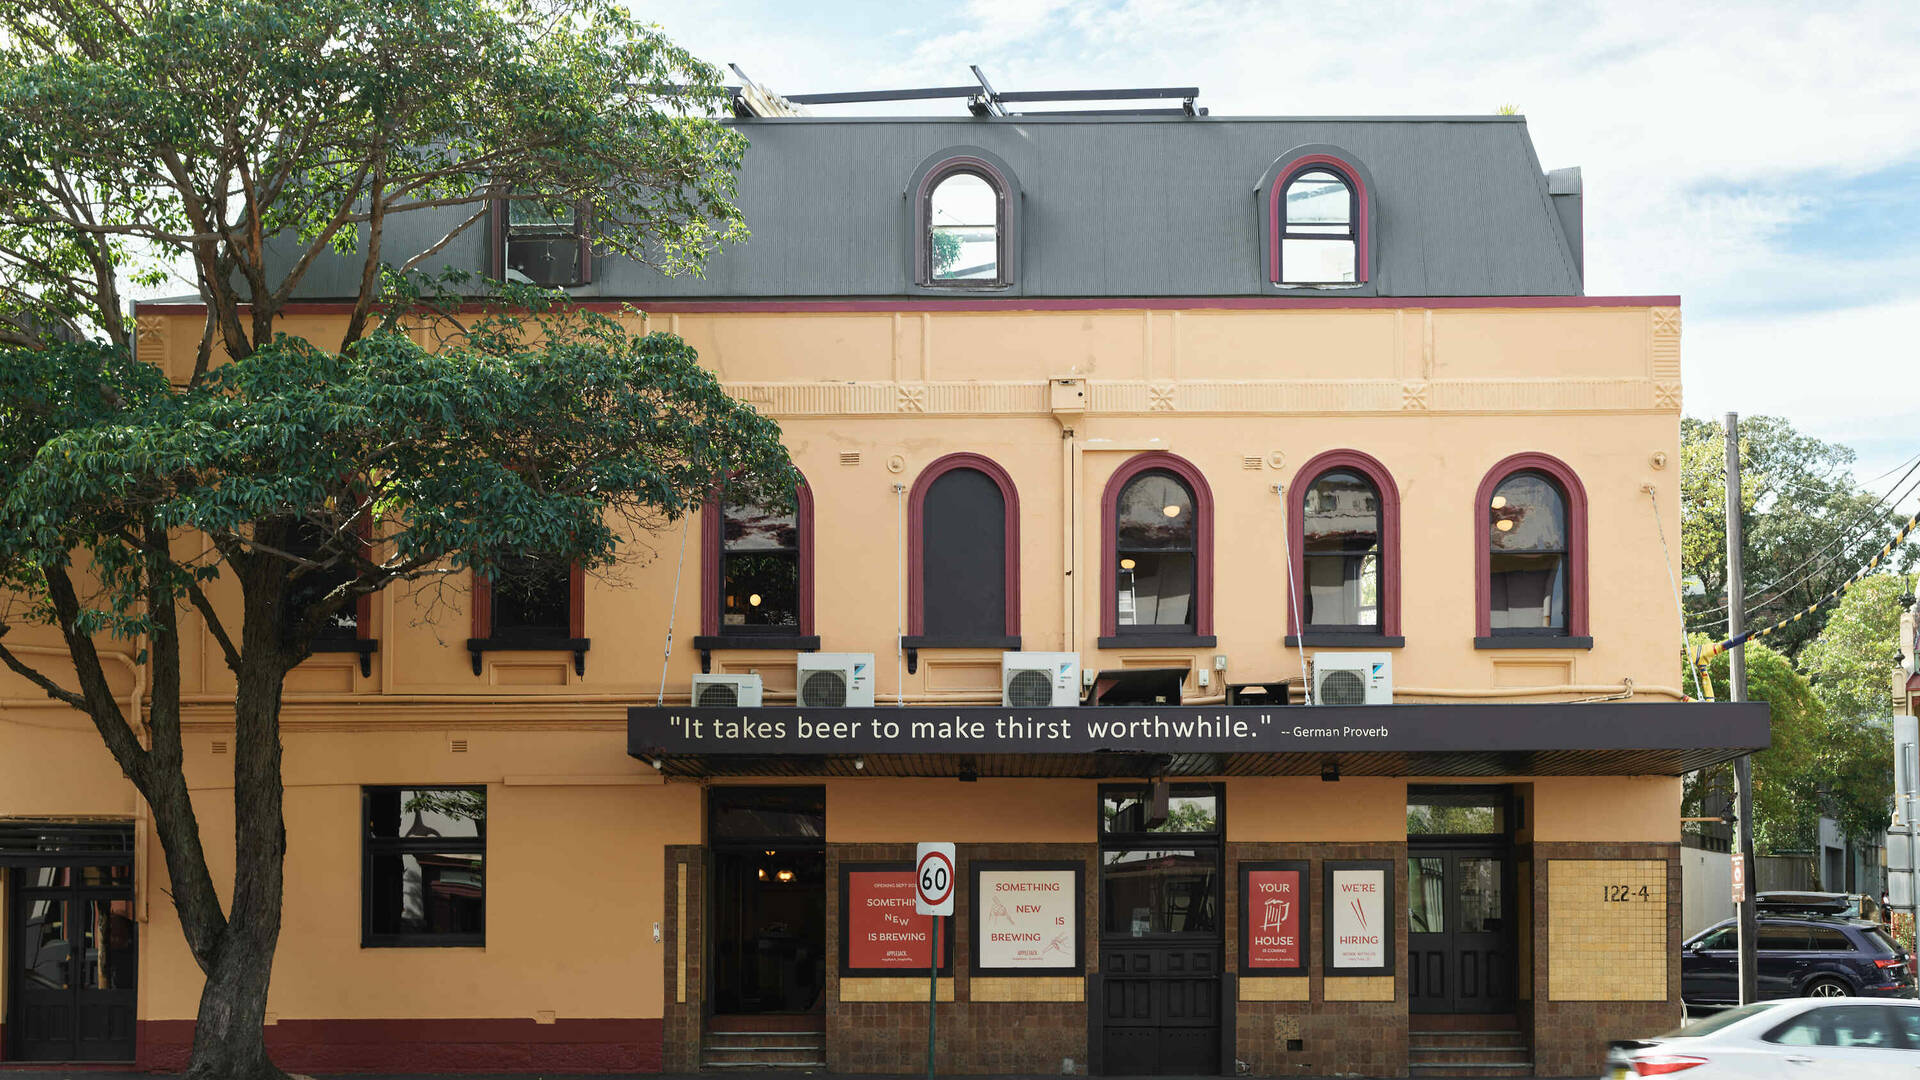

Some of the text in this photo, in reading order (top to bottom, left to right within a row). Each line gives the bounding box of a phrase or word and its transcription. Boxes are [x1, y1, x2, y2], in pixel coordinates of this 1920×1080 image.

[670, 714, 1271, 739] "It takes beer to make thirst worthwhile."
[1293, 726, 1340, 738] German
[1344, 725, 1389, 738] Proverb
[922, 867, 947, 891] 60
[995, 882, 1060, 892] SOMETHING
[1258, 883, 1290, 893] YOUR
[1341, 883, 1376, 893] WE'RE
[1604, 885, 1650, 902] 122-4
[866, 898, 916, 907] SOMETHIN
[1016, 904, 1041, 913] NEW
[885, 913, 909, 926] NEW
[1055, 917, 1065, 926] IS
[868, 933, 926, 941] IS BREWING
[991, 933, 1041, 943] BREWING
[1255, 936, 1294, 945] HOUSE
[1339, 936, 1379, 945] HIRING
